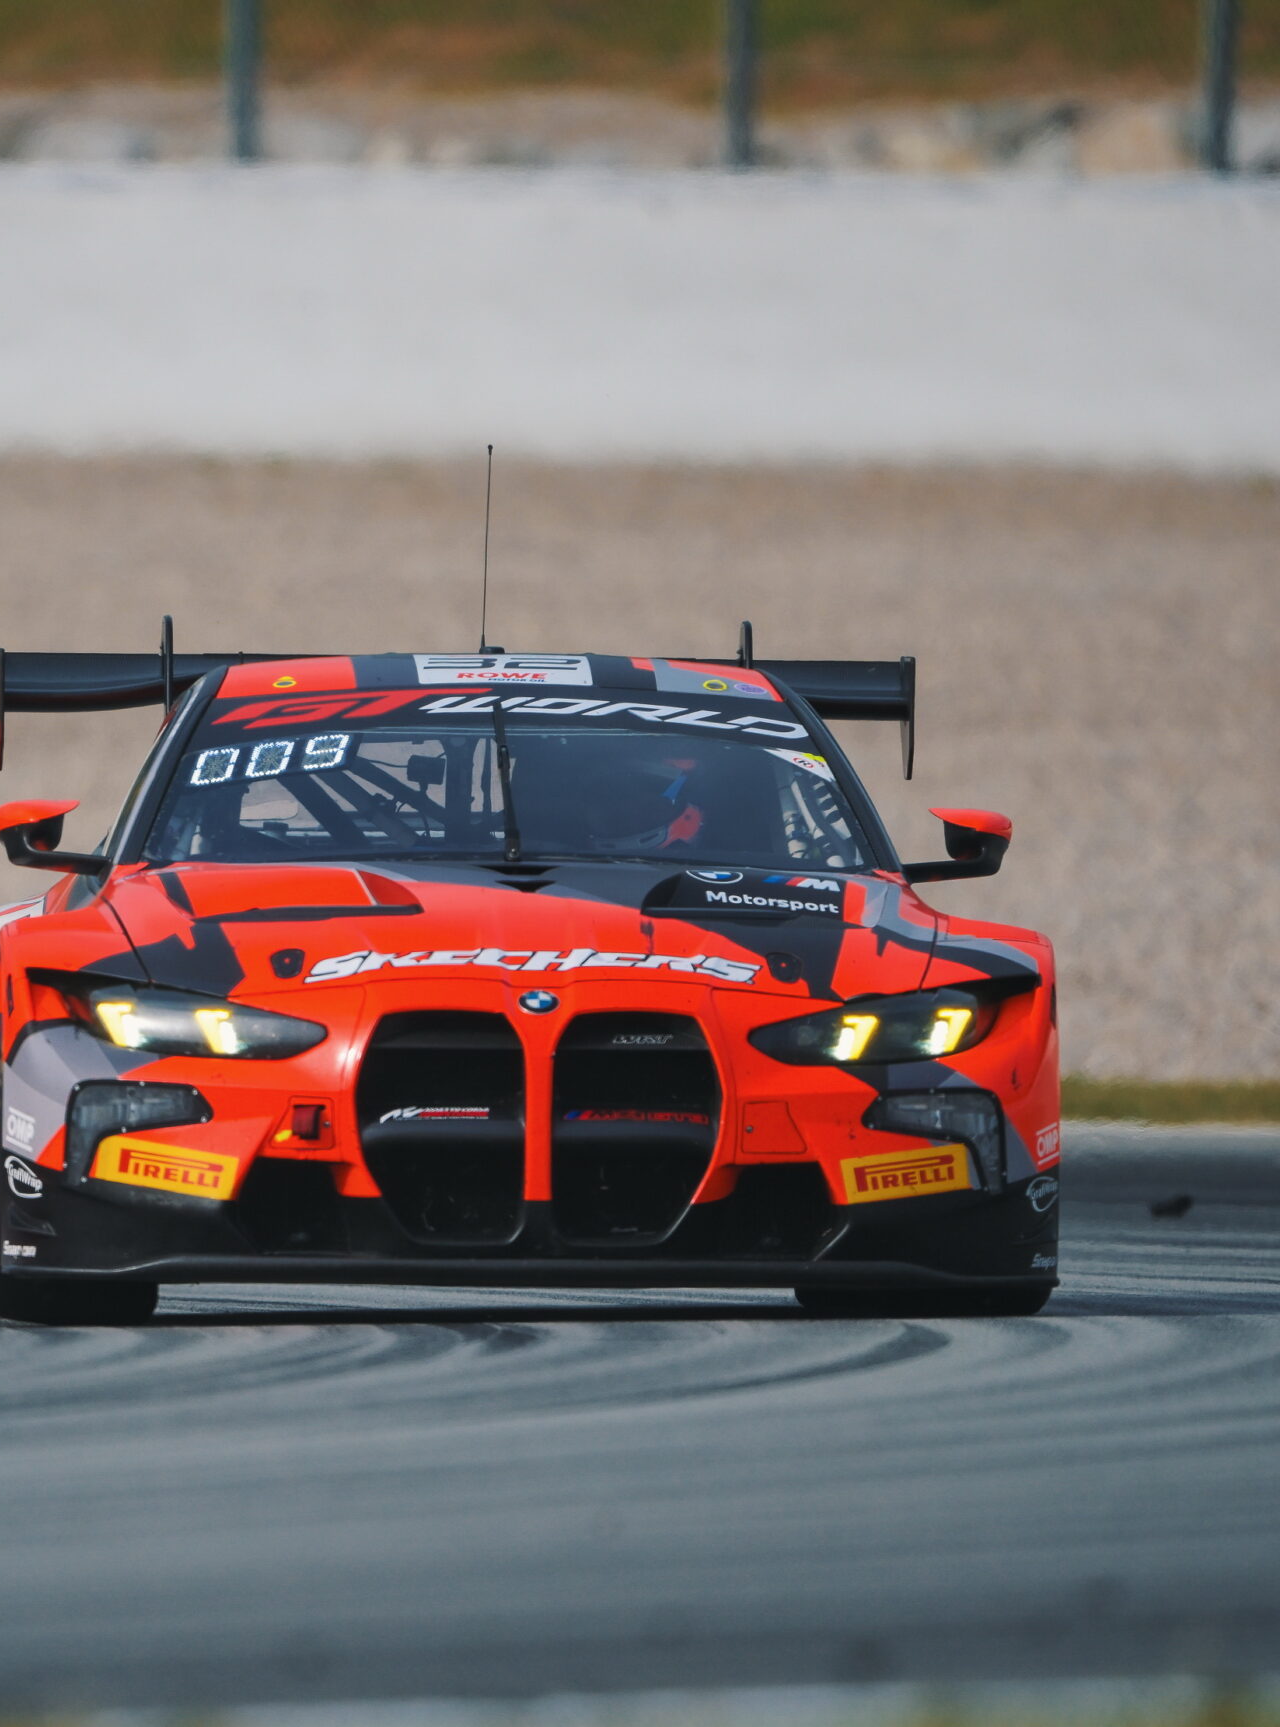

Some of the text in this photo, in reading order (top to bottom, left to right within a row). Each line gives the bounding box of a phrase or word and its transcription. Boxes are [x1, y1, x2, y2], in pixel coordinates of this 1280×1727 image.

[423, 658, 582, 670] 32
[456, 672, 547, 680] ROWE
[211, 687, 810, 739] GT WORLD
[189, 733, 350, 786] 009
[705, 889, 840, 914] Motorsport
[118, 1148, 225, 1189] PIRELLI
[853, 1154, 955, 1193] PIRELLI
